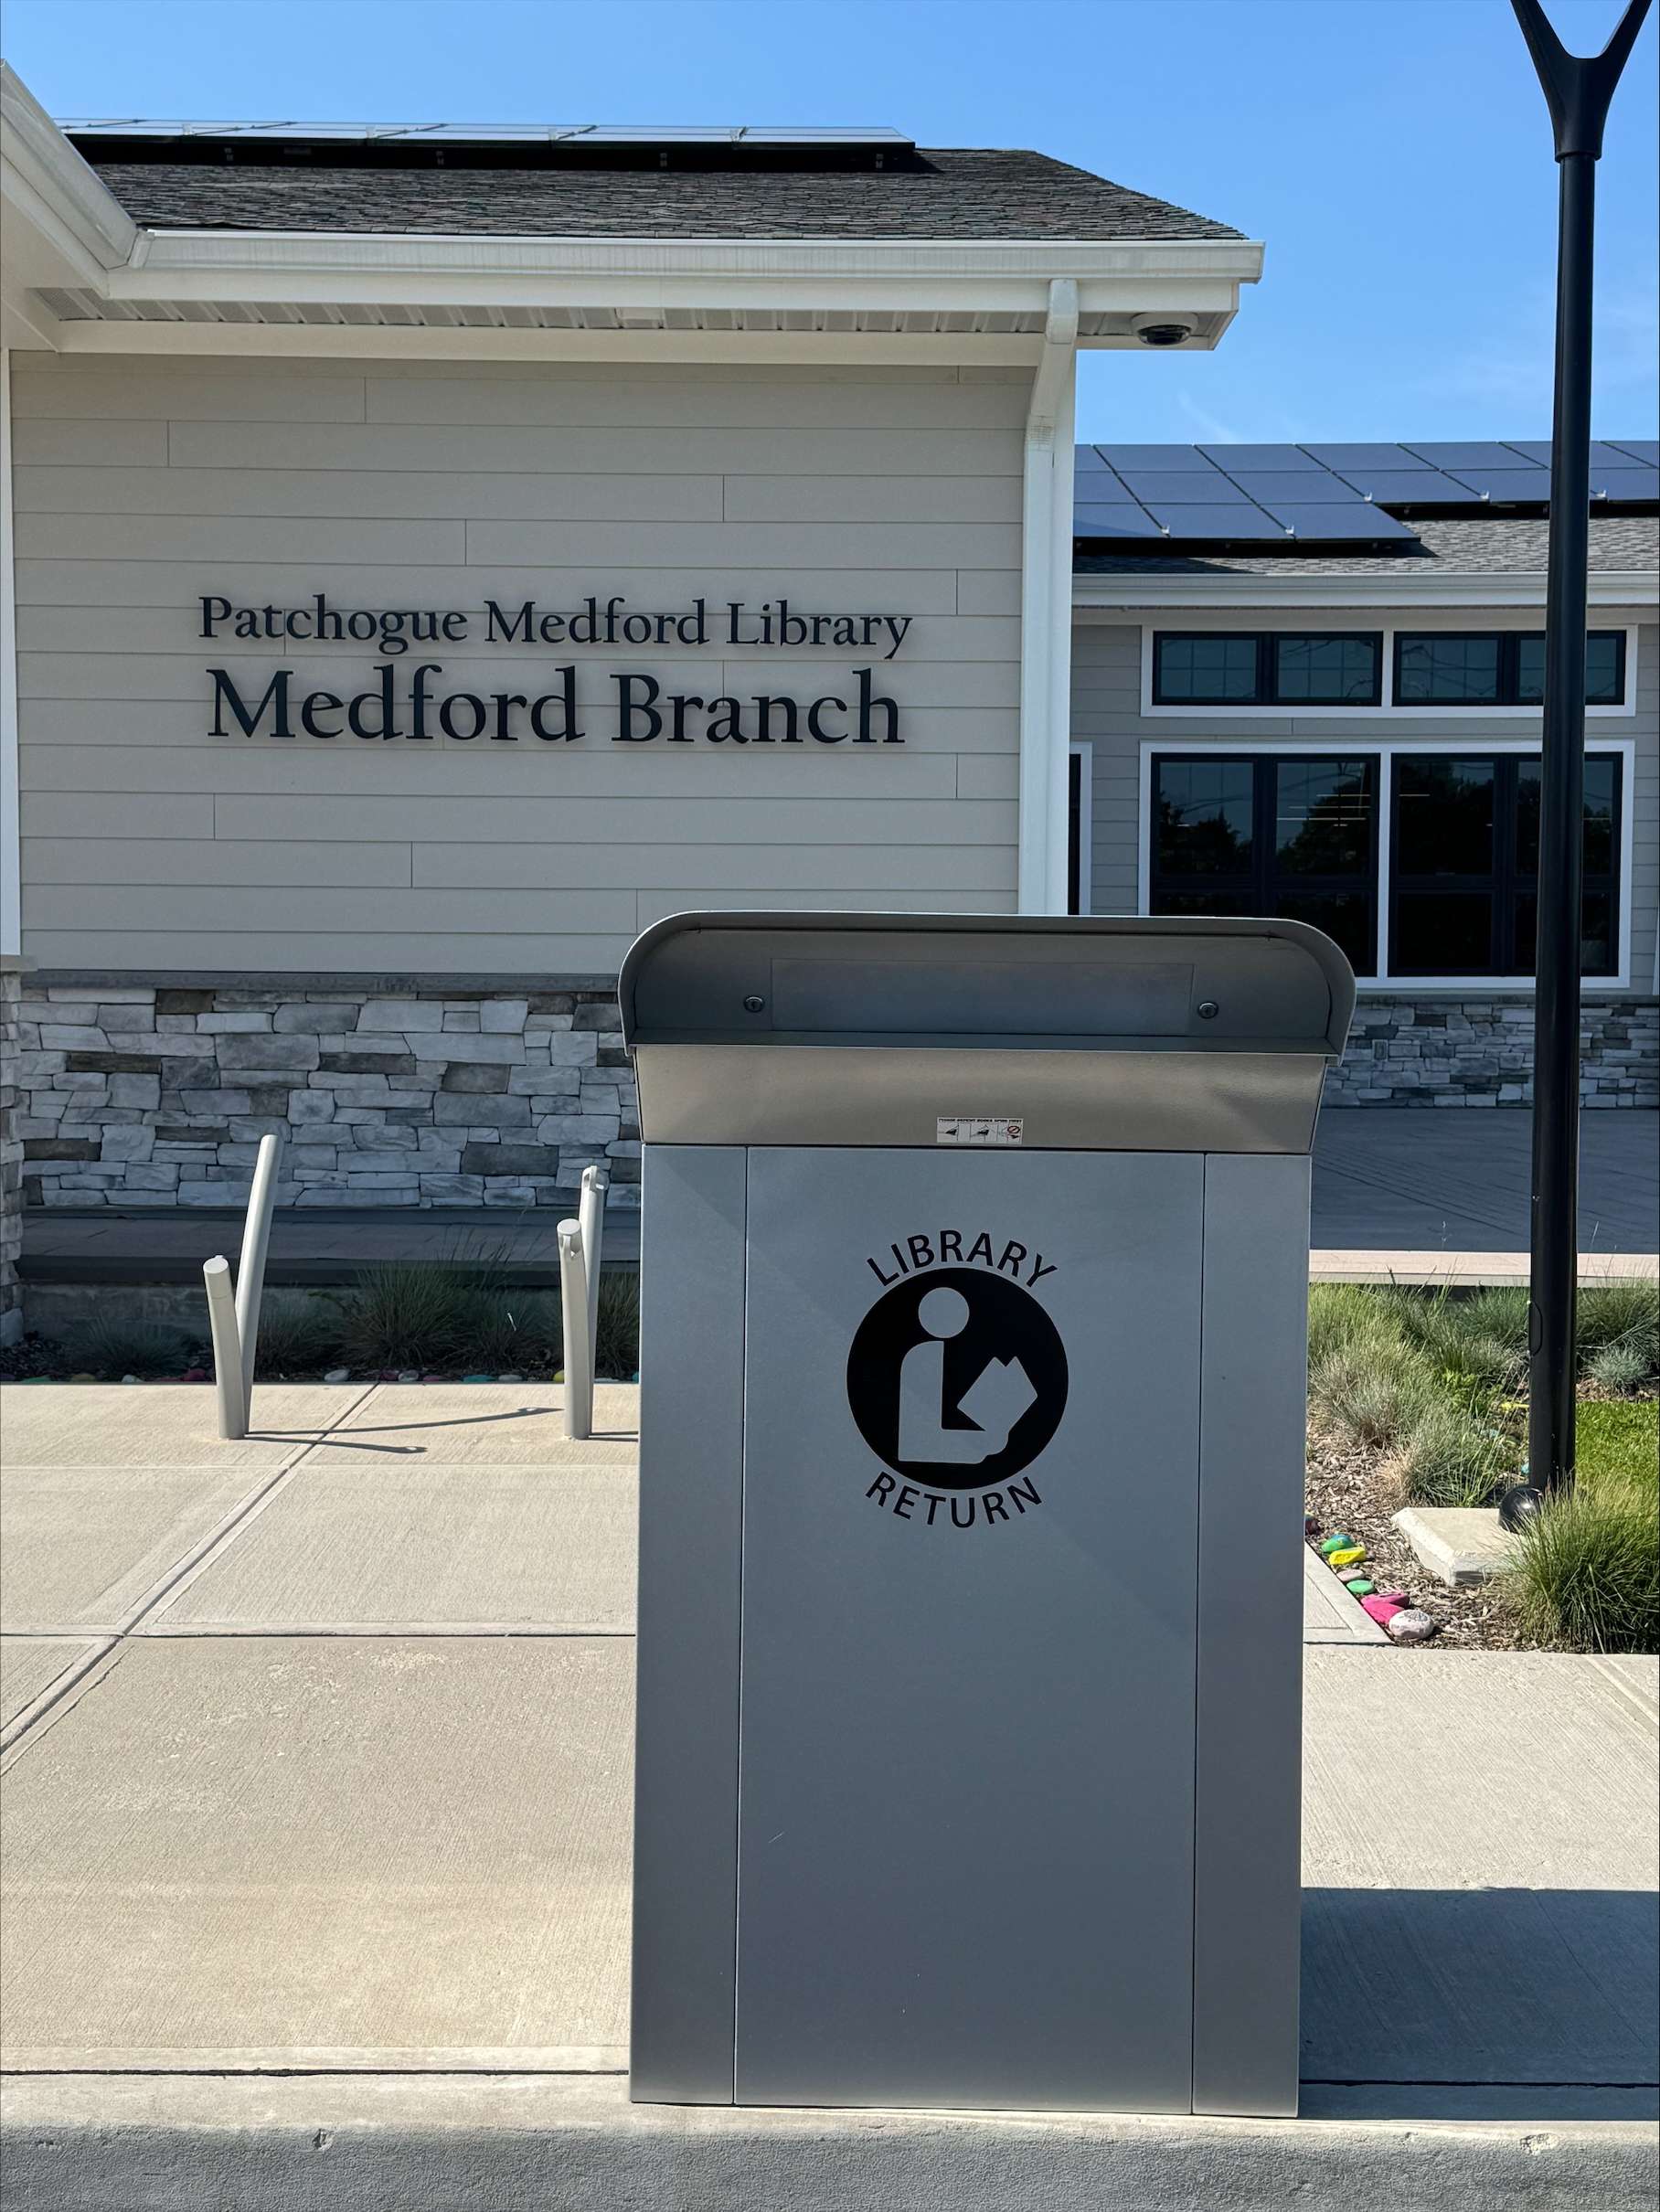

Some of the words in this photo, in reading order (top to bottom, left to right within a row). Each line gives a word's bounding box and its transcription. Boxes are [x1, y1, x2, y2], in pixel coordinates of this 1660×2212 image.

[198, 593, 469, 655] Patchogue
[484, 597, 710, 645] Medford
[726, 599, 913, 660] Library
[207, 664, 585, 742] Medford
[610, 668, 905, 745] Branch
[867, 1229, 1058, 1288] LIBRARY
[865, 1471, 1042, 1528] RETURN
